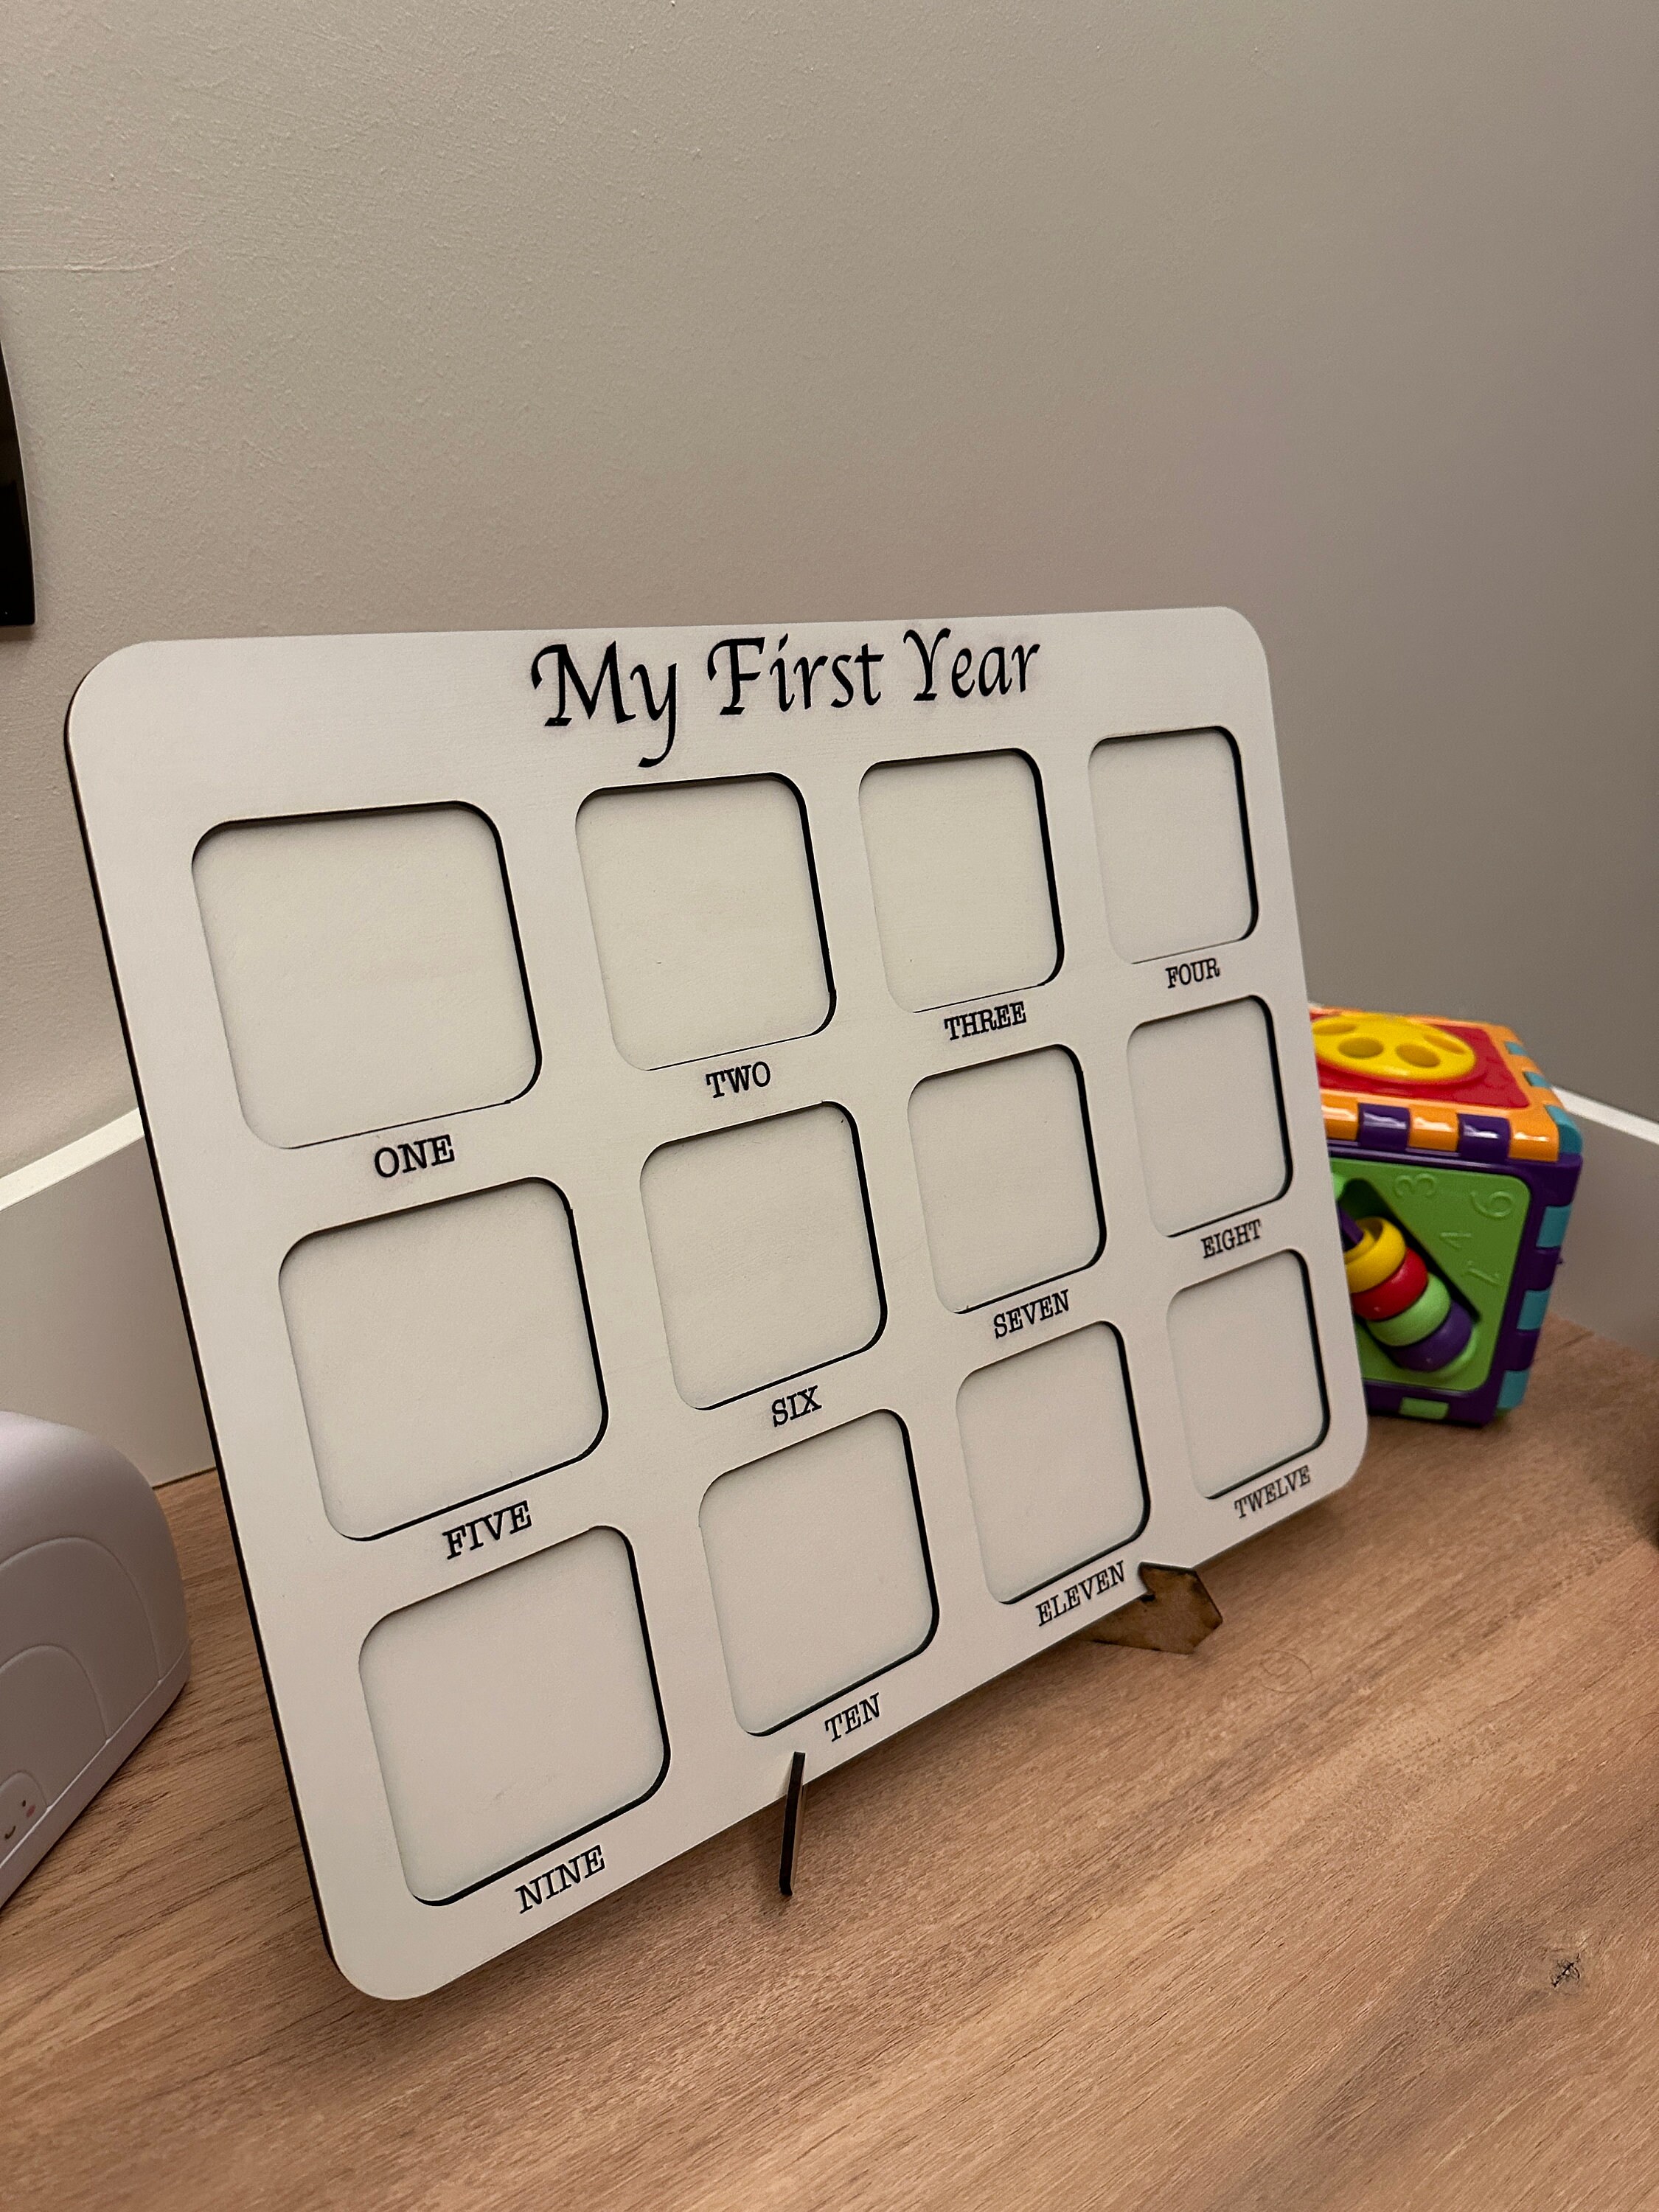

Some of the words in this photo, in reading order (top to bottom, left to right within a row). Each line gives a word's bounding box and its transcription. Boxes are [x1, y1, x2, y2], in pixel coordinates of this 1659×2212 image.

[530, 640, 678, 768] My
[706, 633, 886, 716] First
[902, 627, 1041, 702] Year
[1164, 957, 1221, 990] FOUR
[943, 1001, 1027, 1041] THREE
[705, 1061, 771, 1099] TWO
[374, 1133, 455, 1178] ONE
[1200, 1218, 1262, 1259] EIGHT
[993, 1288, 1070, 1340] SEVEN
[771, 1385, 823, 1428] SIX
[1234, 1464, 1312, 1519] TWELVE
[441, 1500, 532, 1560] FIVE
[1034, 1559, 1125, 1627] ELEVEN
[824, 1691, 880, 1742] TEN
[514, 1844, 605, 1915] NINE
